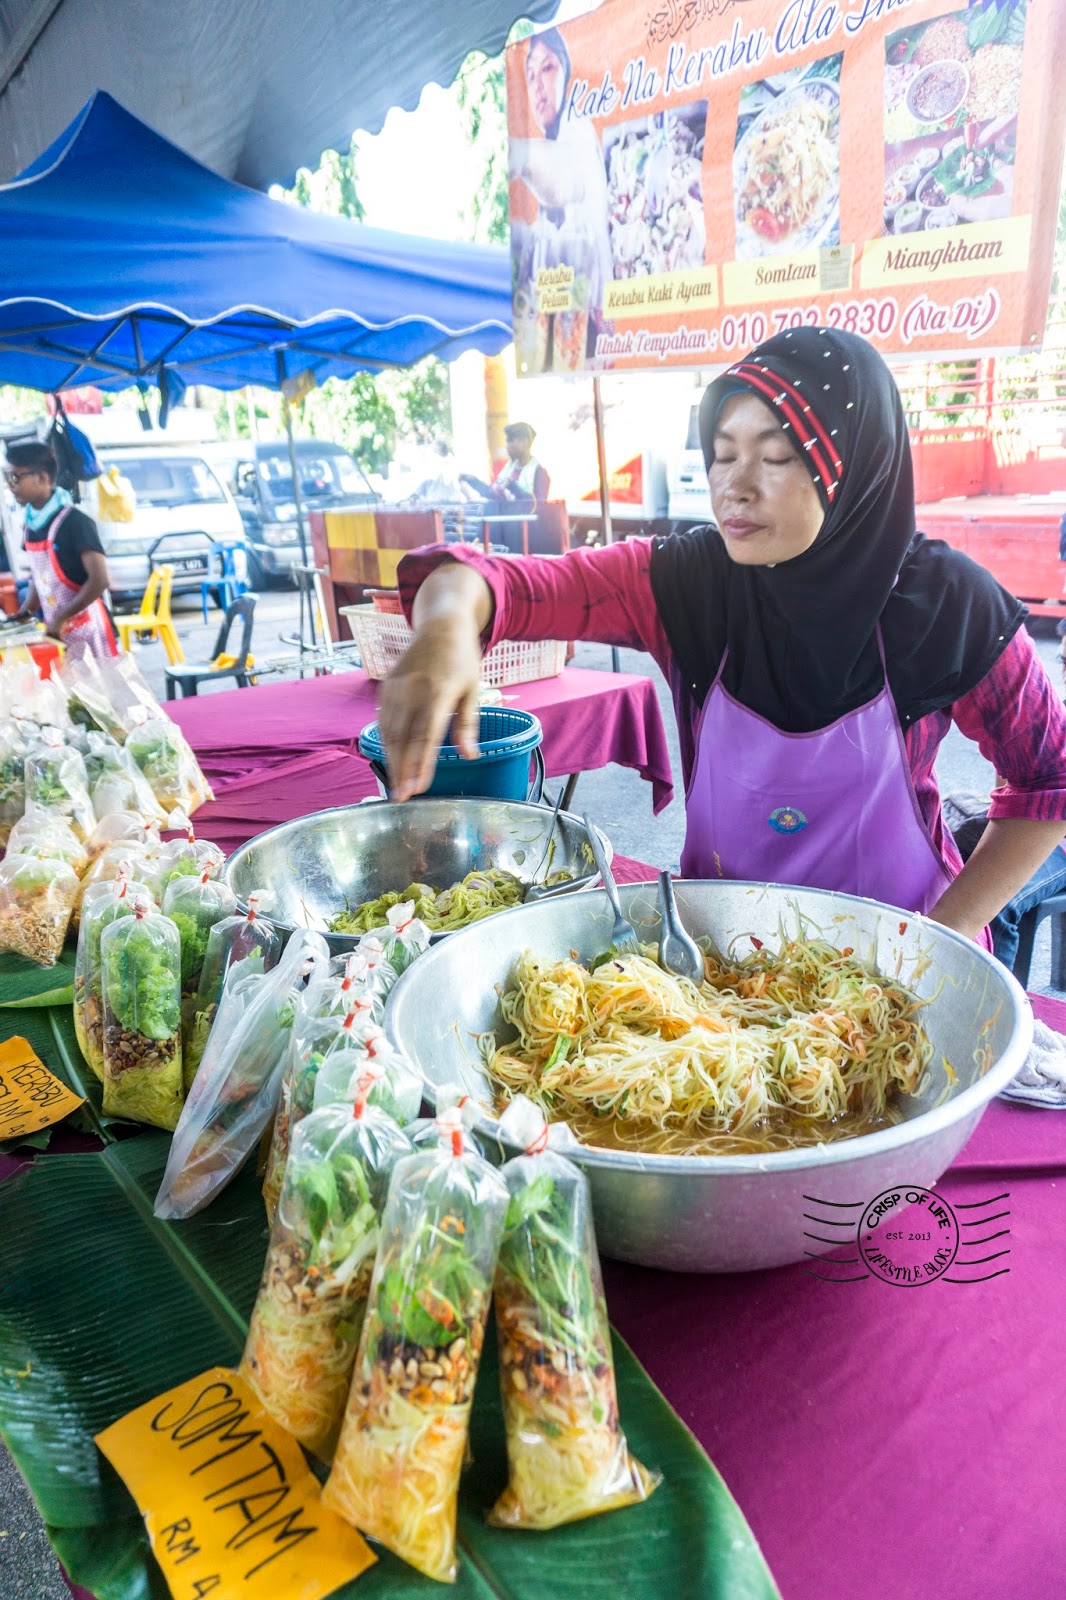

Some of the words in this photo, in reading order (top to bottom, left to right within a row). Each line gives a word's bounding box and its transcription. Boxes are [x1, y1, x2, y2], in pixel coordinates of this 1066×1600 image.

[567, 77, 616, 121] Kak
[623, 60, 657, 105] Na
[666, 22, 768, 92] Kerabu
[775, 0, 840, 53] Ala
[755, 262, 817, 286] Somtam
[883, 239, 1004, 272] Miangkham
[608, 289, 645, 308] Kerabu
[648, 283, 673, 301] Kaki
[677, 281, 712, 303] Ayam
[598, 335, 633, 356] Untuk
[722, 317, 764, 346] 010
[829, 302, 895, 335] 2830
[903, 299, 946, 339] (Na
[953, 292, 996, 336] Di)
[7, 1060, 69, 1107] KERABU
[161, 1517, 200, 1565] RM
